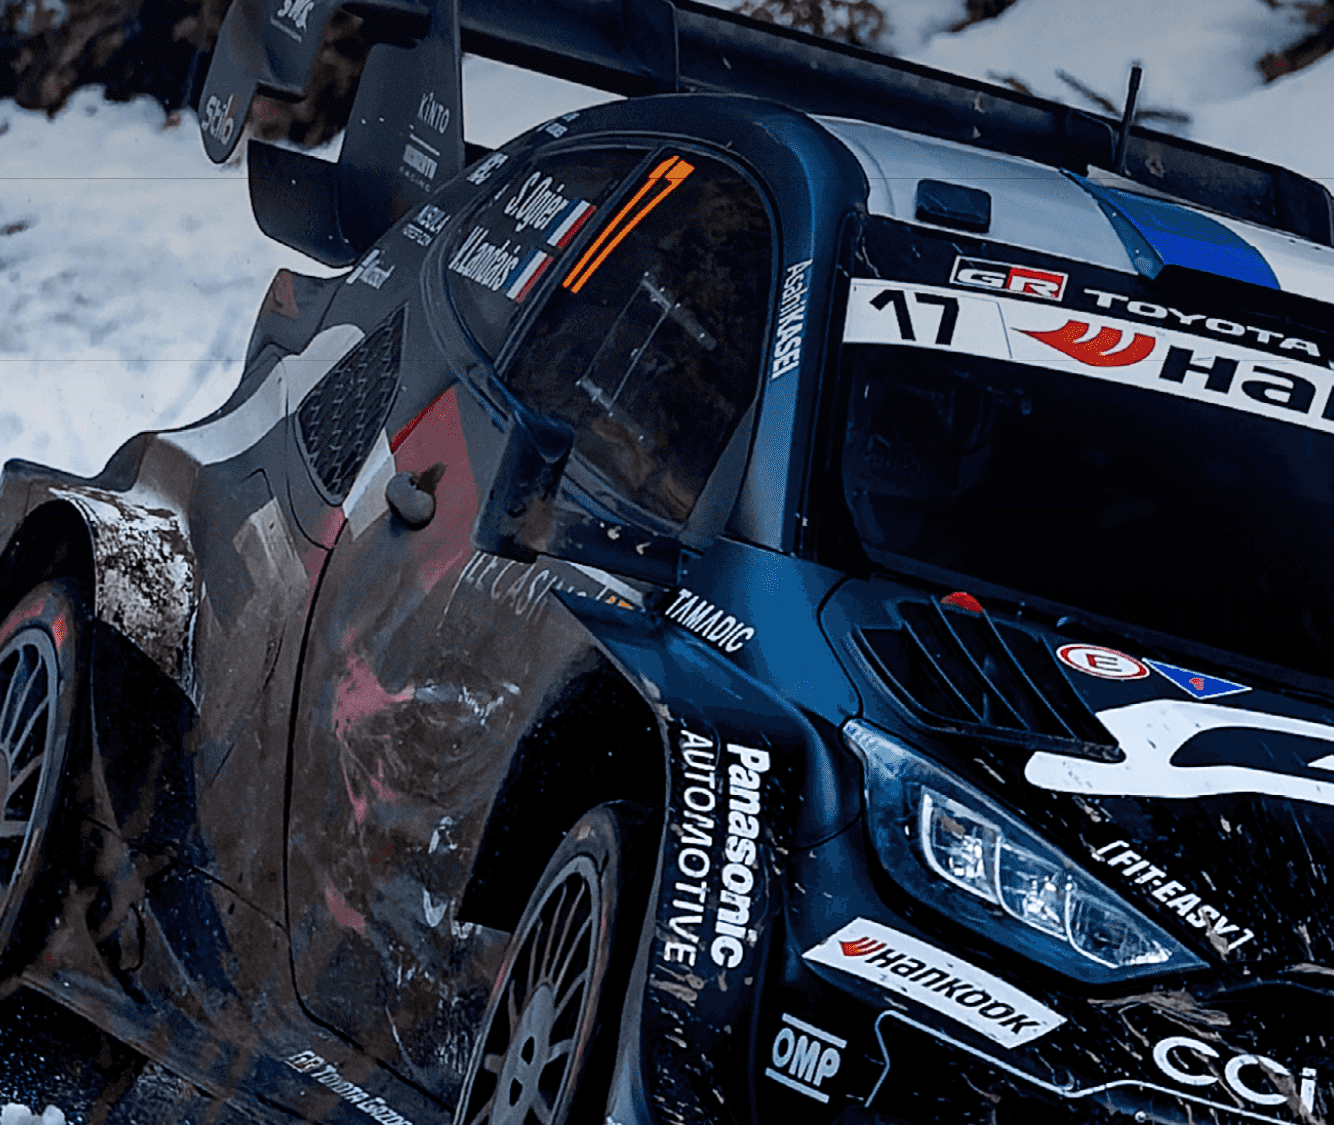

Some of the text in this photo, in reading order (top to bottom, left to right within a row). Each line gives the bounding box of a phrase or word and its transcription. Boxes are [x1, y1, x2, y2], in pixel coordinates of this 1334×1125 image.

[955, 267, 1060, 298] GR
[869, 289, 959, 346] 17
[1083, 288, 1320, 357] TOYOTA
[665, 588, 754, 653] TAMADIC
[664, 729, 716, 967] AUTOMOTIVE
[711, 743, 770, 968] Panasonic
[772, 1027, 841, 1086] OMP
